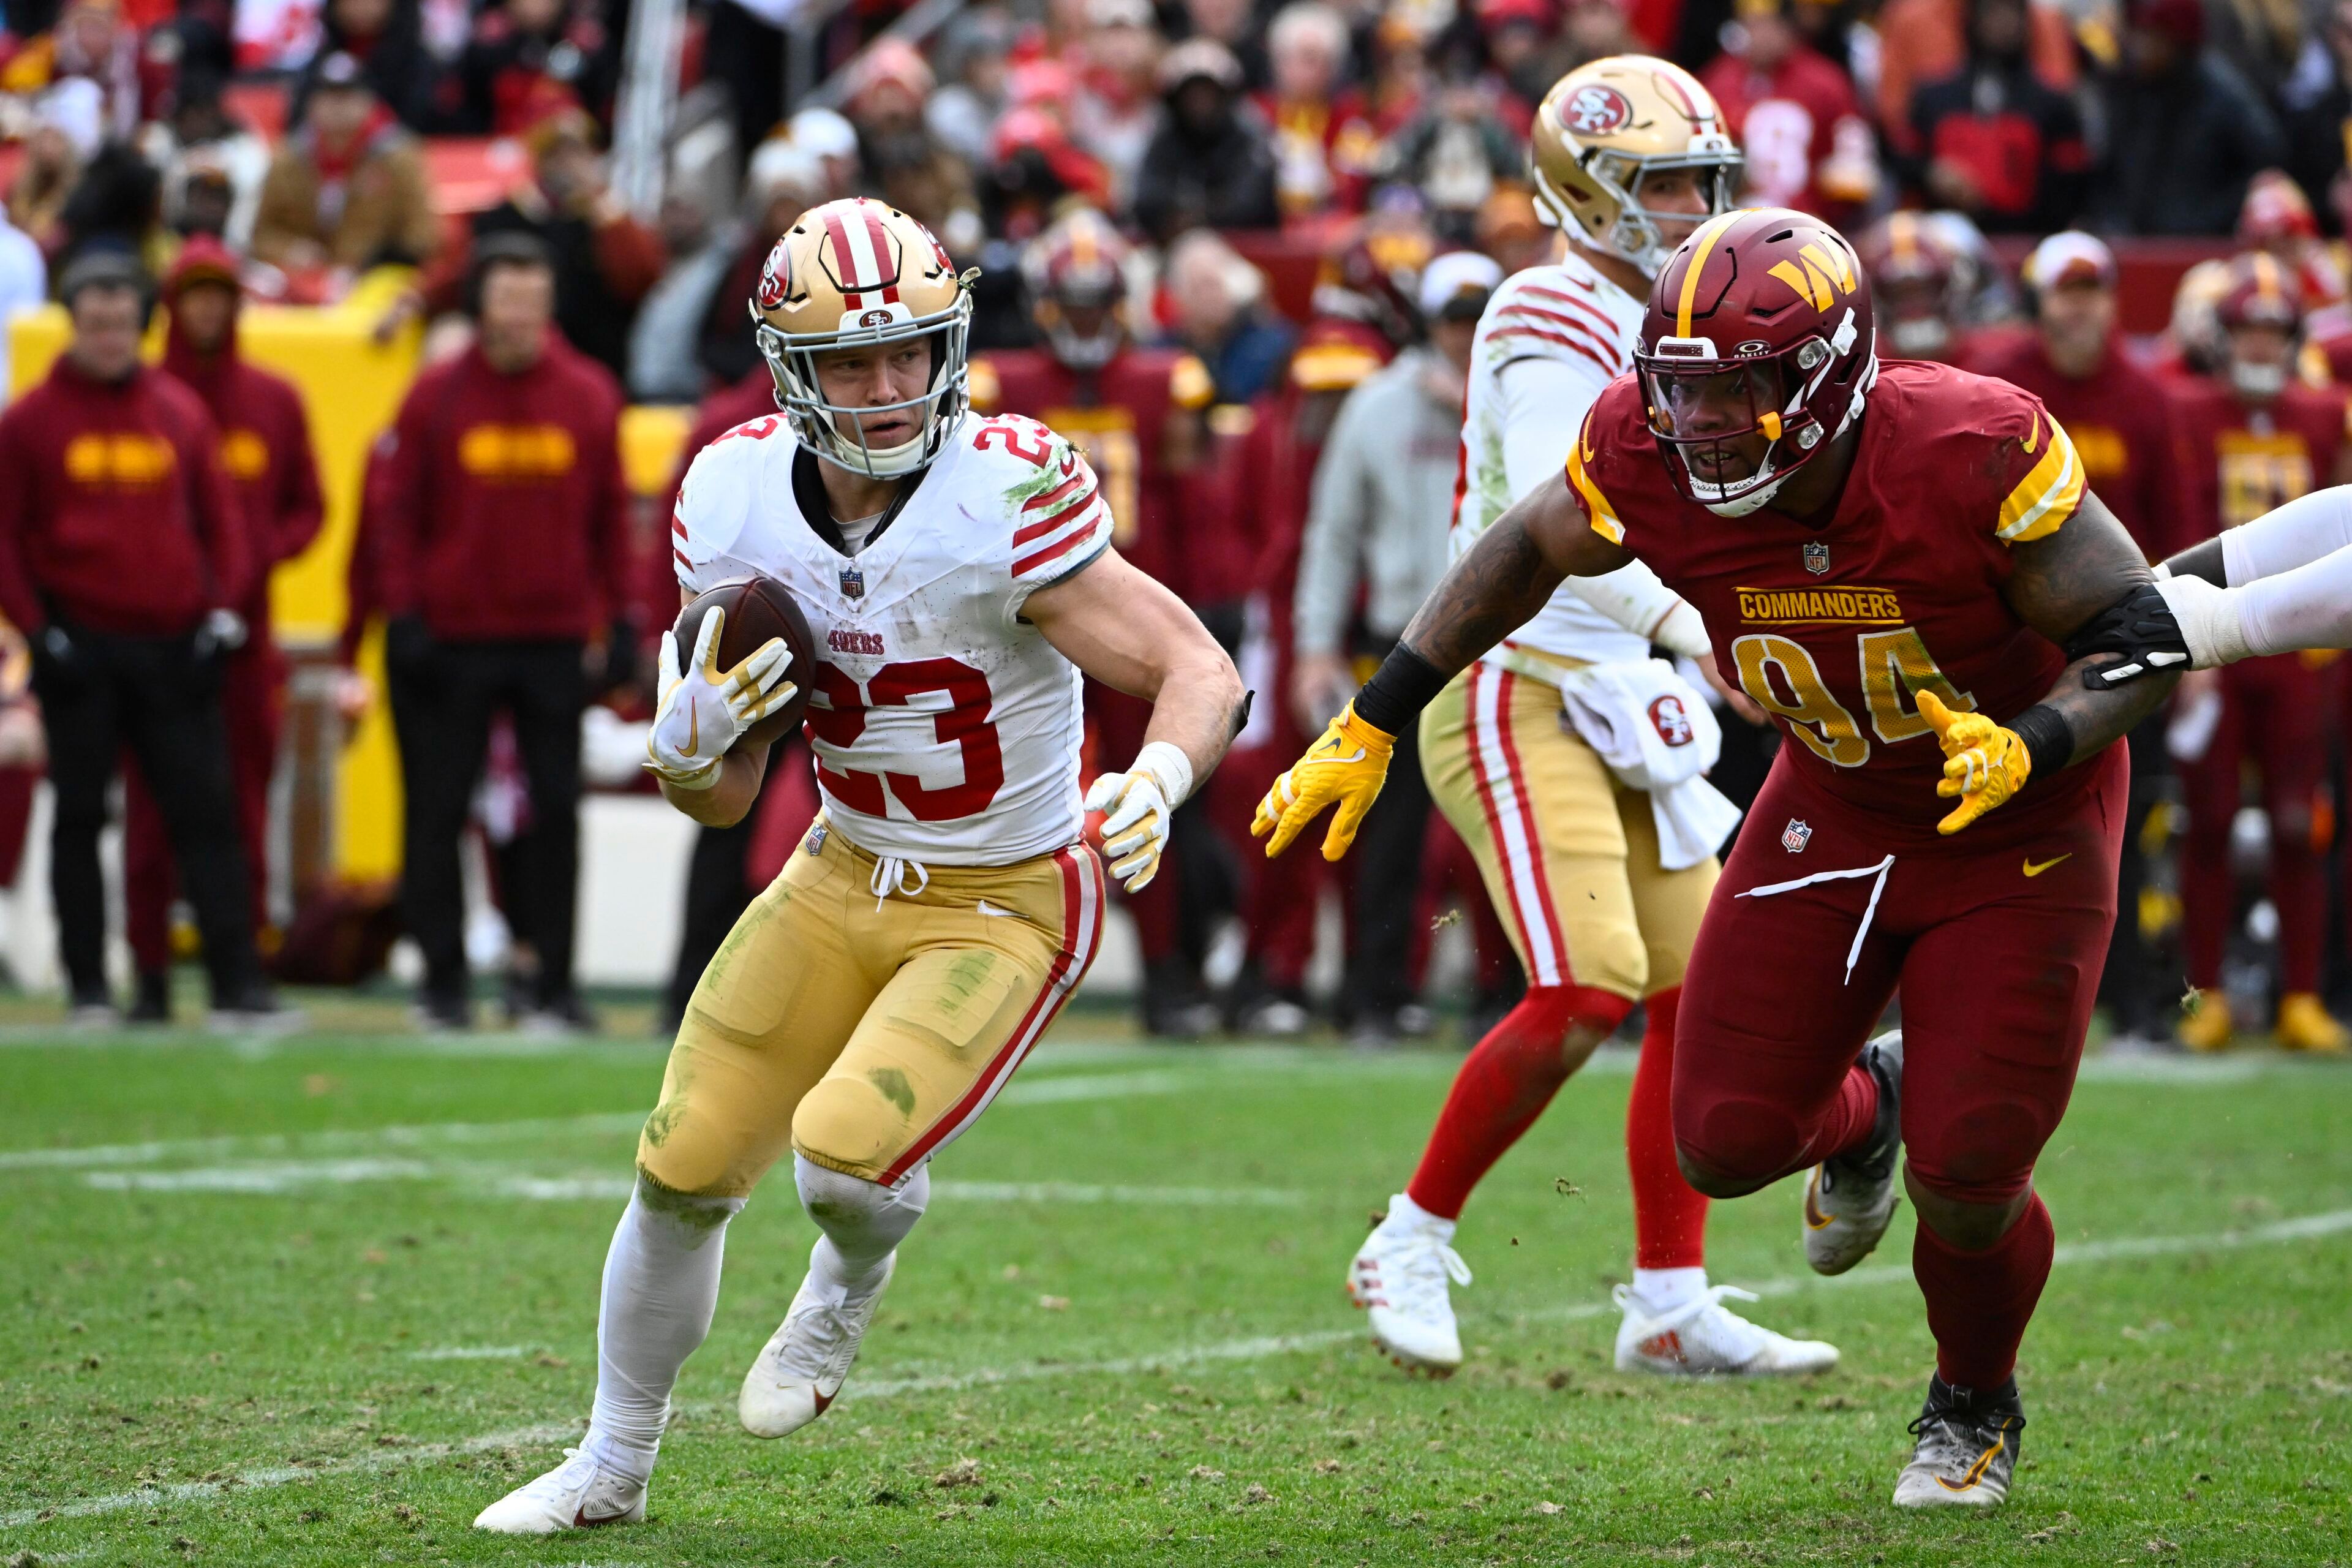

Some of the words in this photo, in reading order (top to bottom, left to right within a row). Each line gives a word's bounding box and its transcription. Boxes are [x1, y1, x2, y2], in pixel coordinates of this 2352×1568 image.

[1766, 233, 1856, 314] W
[1734, 350, 1770, 359] OAKLEY
[1740, 592, 1901, 618] COMMANDERS
[827, 629, 884, 655] 49ERS
[1732, 626, 1978, 767] 94
[803, 657, 1005, 821] 23
